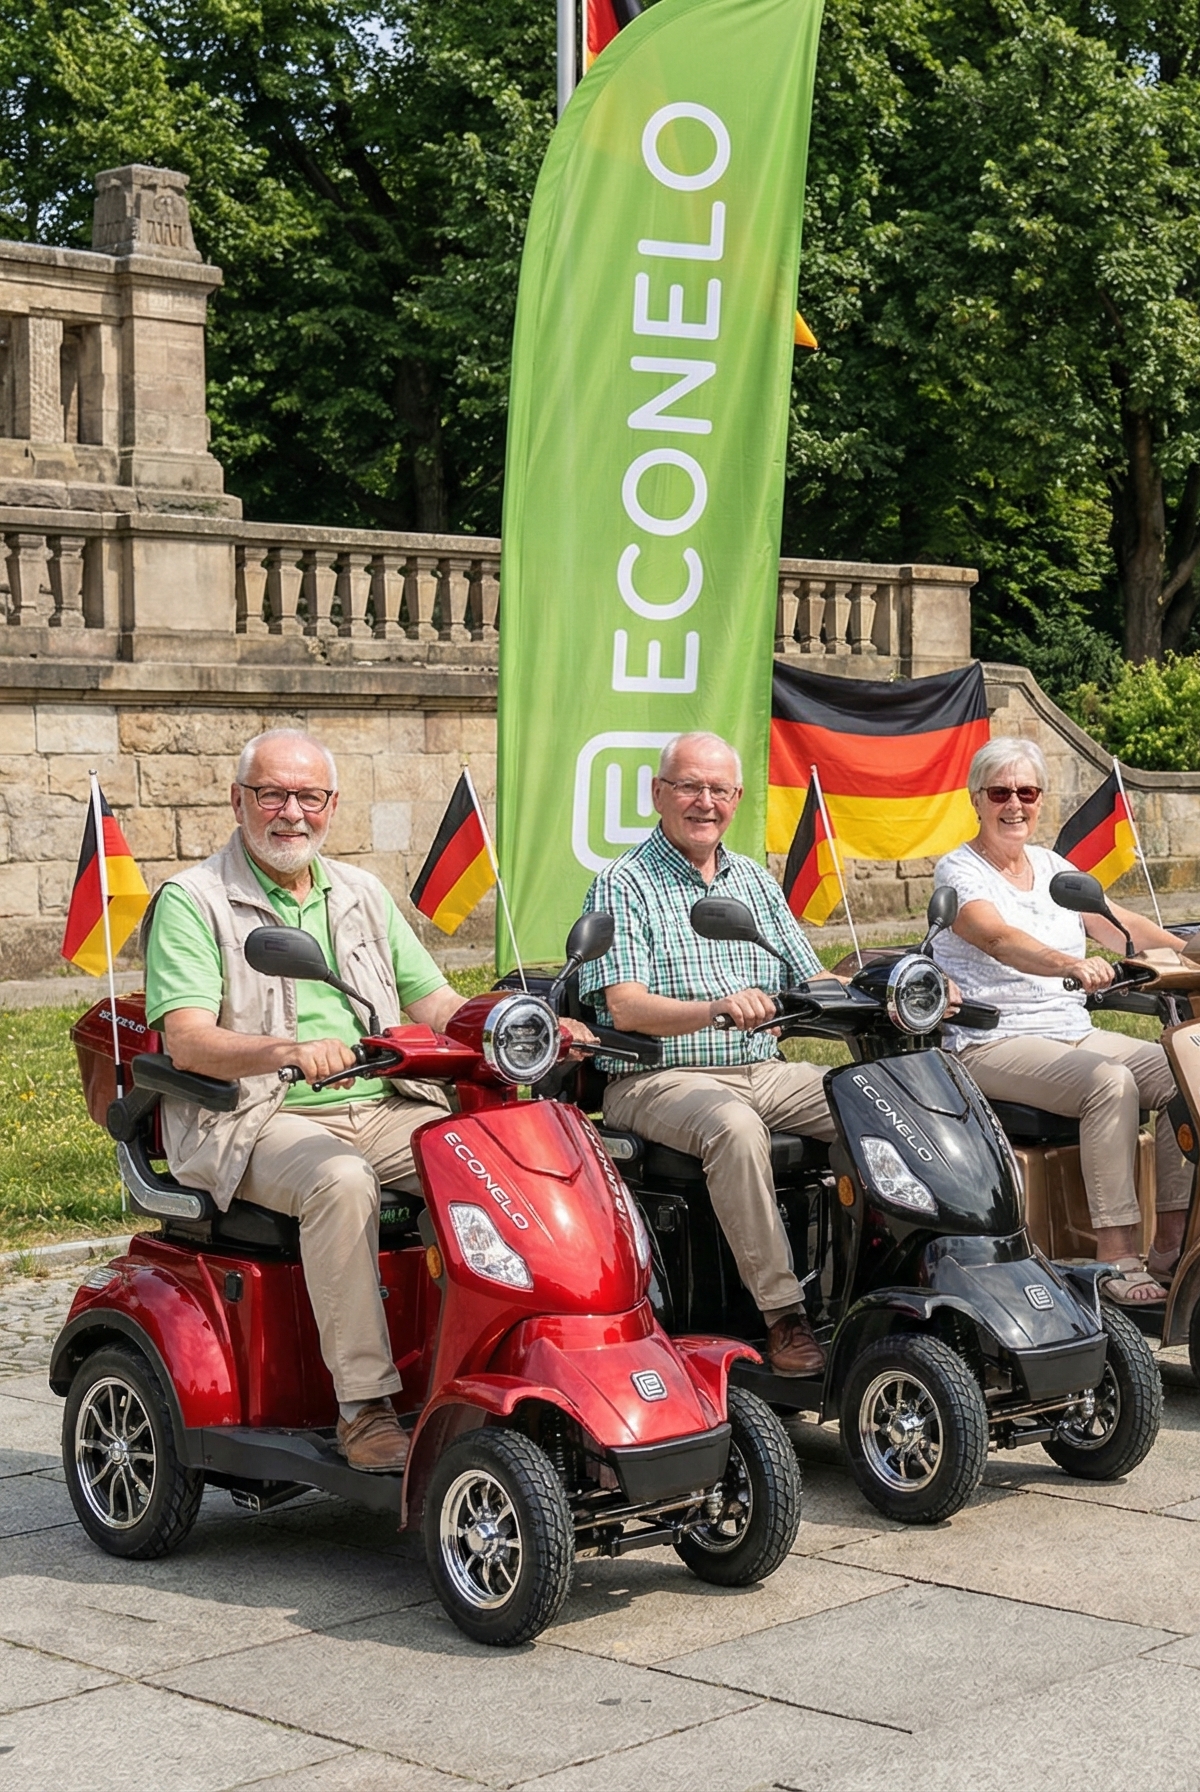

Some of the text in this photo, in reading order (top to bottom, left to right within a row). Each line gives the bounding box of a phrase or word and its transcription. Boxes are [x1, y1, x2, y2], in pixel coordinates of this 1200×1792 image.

[612, 101, 731, 694] ECONELO
[852, 1074, 933, 1162] ECONELO
[444, 1131, 529, 1231] ECONELO
